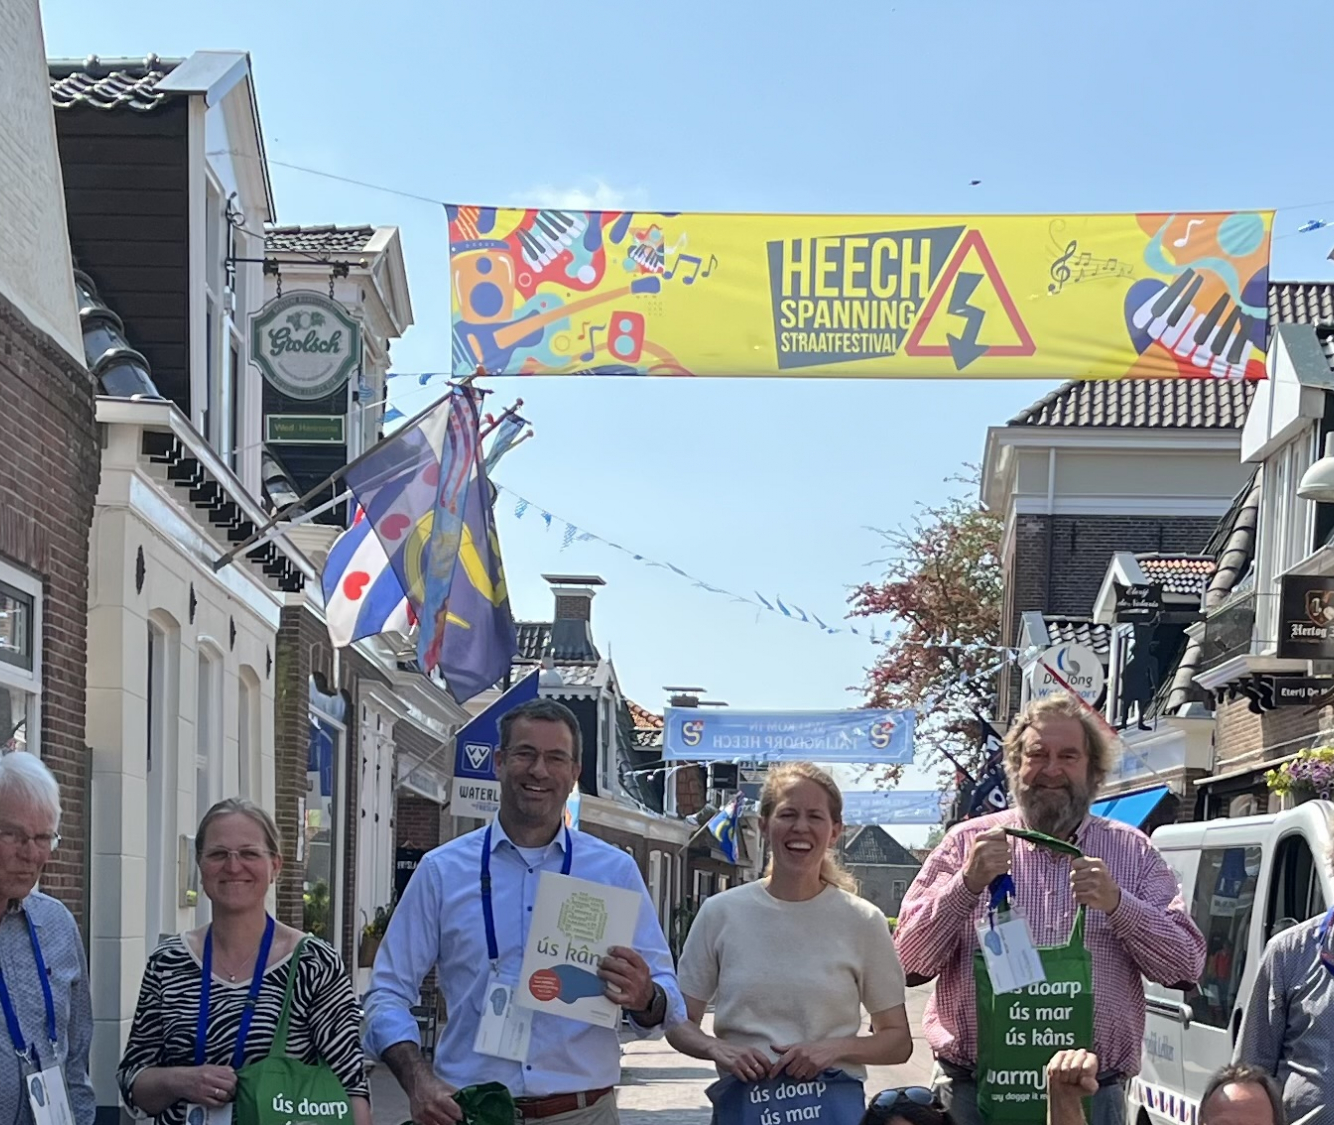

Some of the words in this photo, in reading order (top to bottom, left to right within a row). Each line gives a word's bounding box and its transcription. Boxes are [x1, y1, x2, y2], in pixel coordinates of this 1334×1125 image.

[782, 237, 931, 298] HEECH
[780, 300, 915, 330] SPANNING
[268, 327, 342, 356] Grolsch
[781, 332, 898, 353] STRAATFESTIVAL
[1291, 624, 1327, 639] Hertog
[1280, 687, 1306, 698] Eterij
[459, 785, 499, 802] WATERL
[536, 936, 559, 957] ús
[565, 940, 602, 968] kân
[1009, 1001, 1030, 1021] ús
[1035, 1006, 1073, 1021] mar
[1005, 1027, 1026, 1046] ús
[1031, 1028, 1075, 1046] kâns
[750, 1085, 770, 1104] ús
[775, 1081, 827, 1100] doarp
[272, 1093, 294, 1114] ús
[297, 1098, 348, 1119] doarp
[785, 1104, 822, 1123] mar
